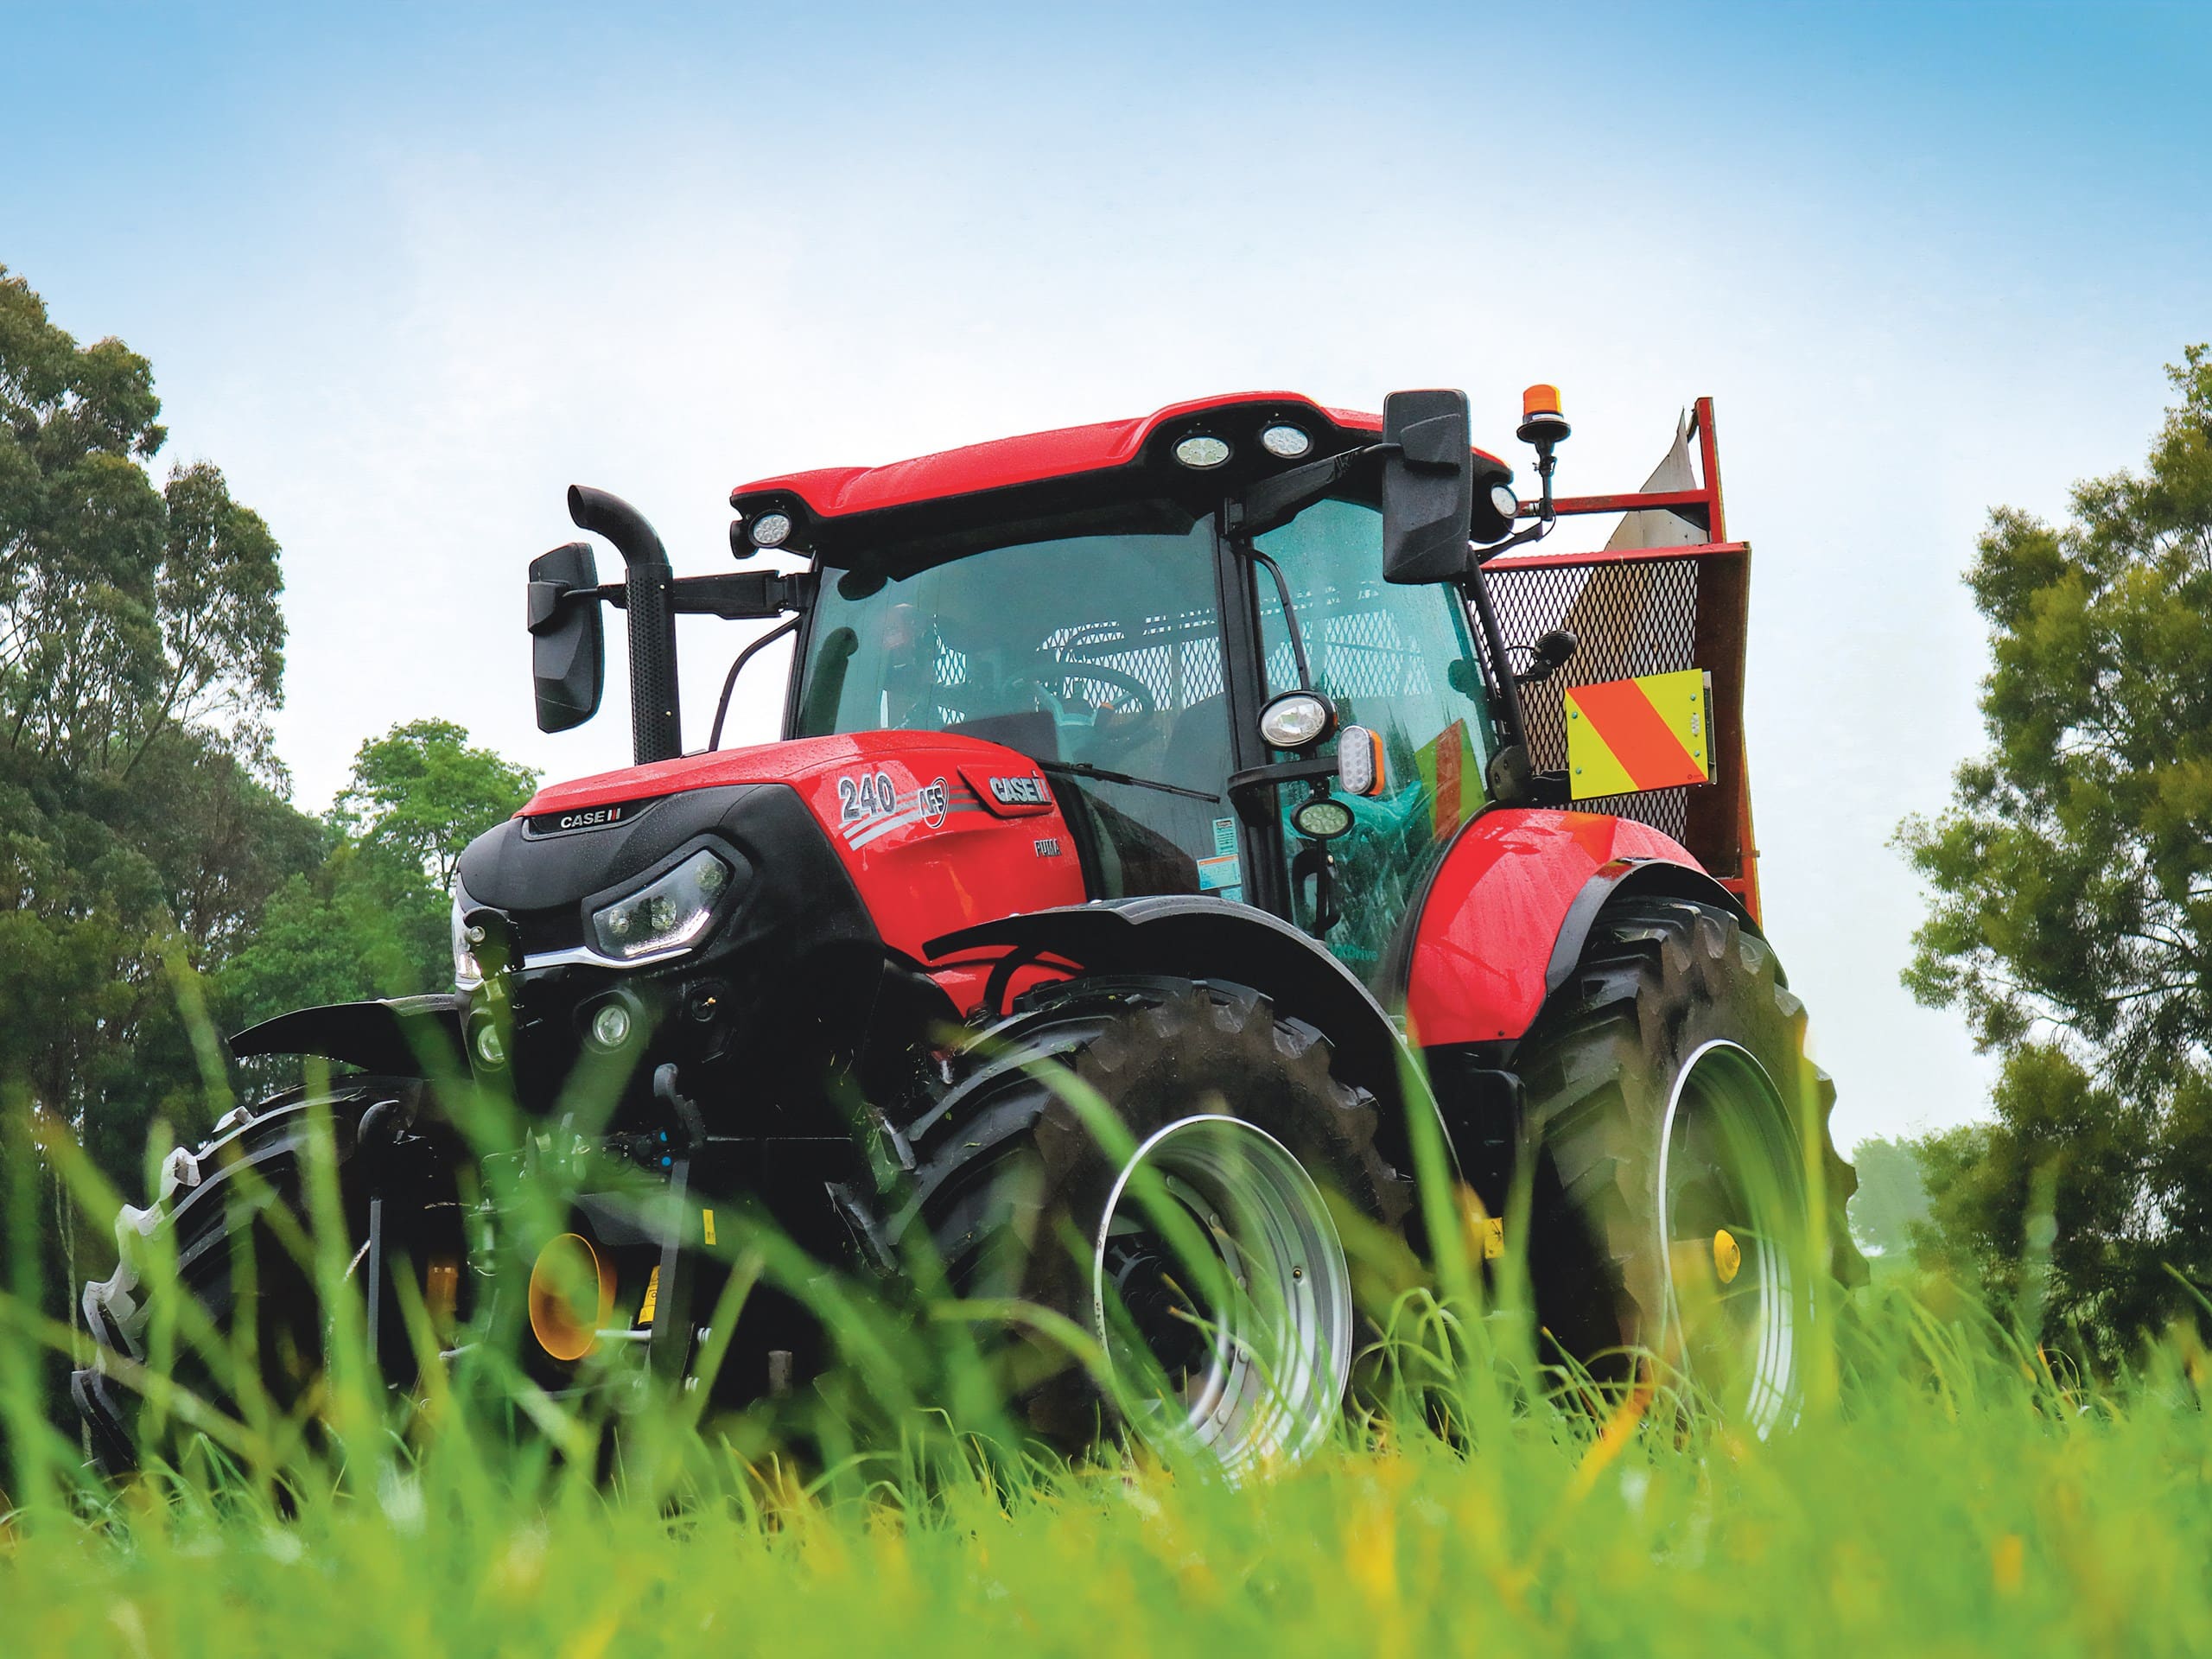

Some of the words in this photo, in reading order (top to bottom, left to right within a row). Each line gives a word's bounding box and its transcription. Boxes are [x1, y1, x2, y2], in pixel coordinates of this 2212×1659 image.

[838, 772, 896, 821] 240
[918, 785, 945, 817] AFS
[989, 776, 1038, 803] CASE
[560, 810, 605, 828] CASE
[1033, 839, 1062, 857] PUMA
